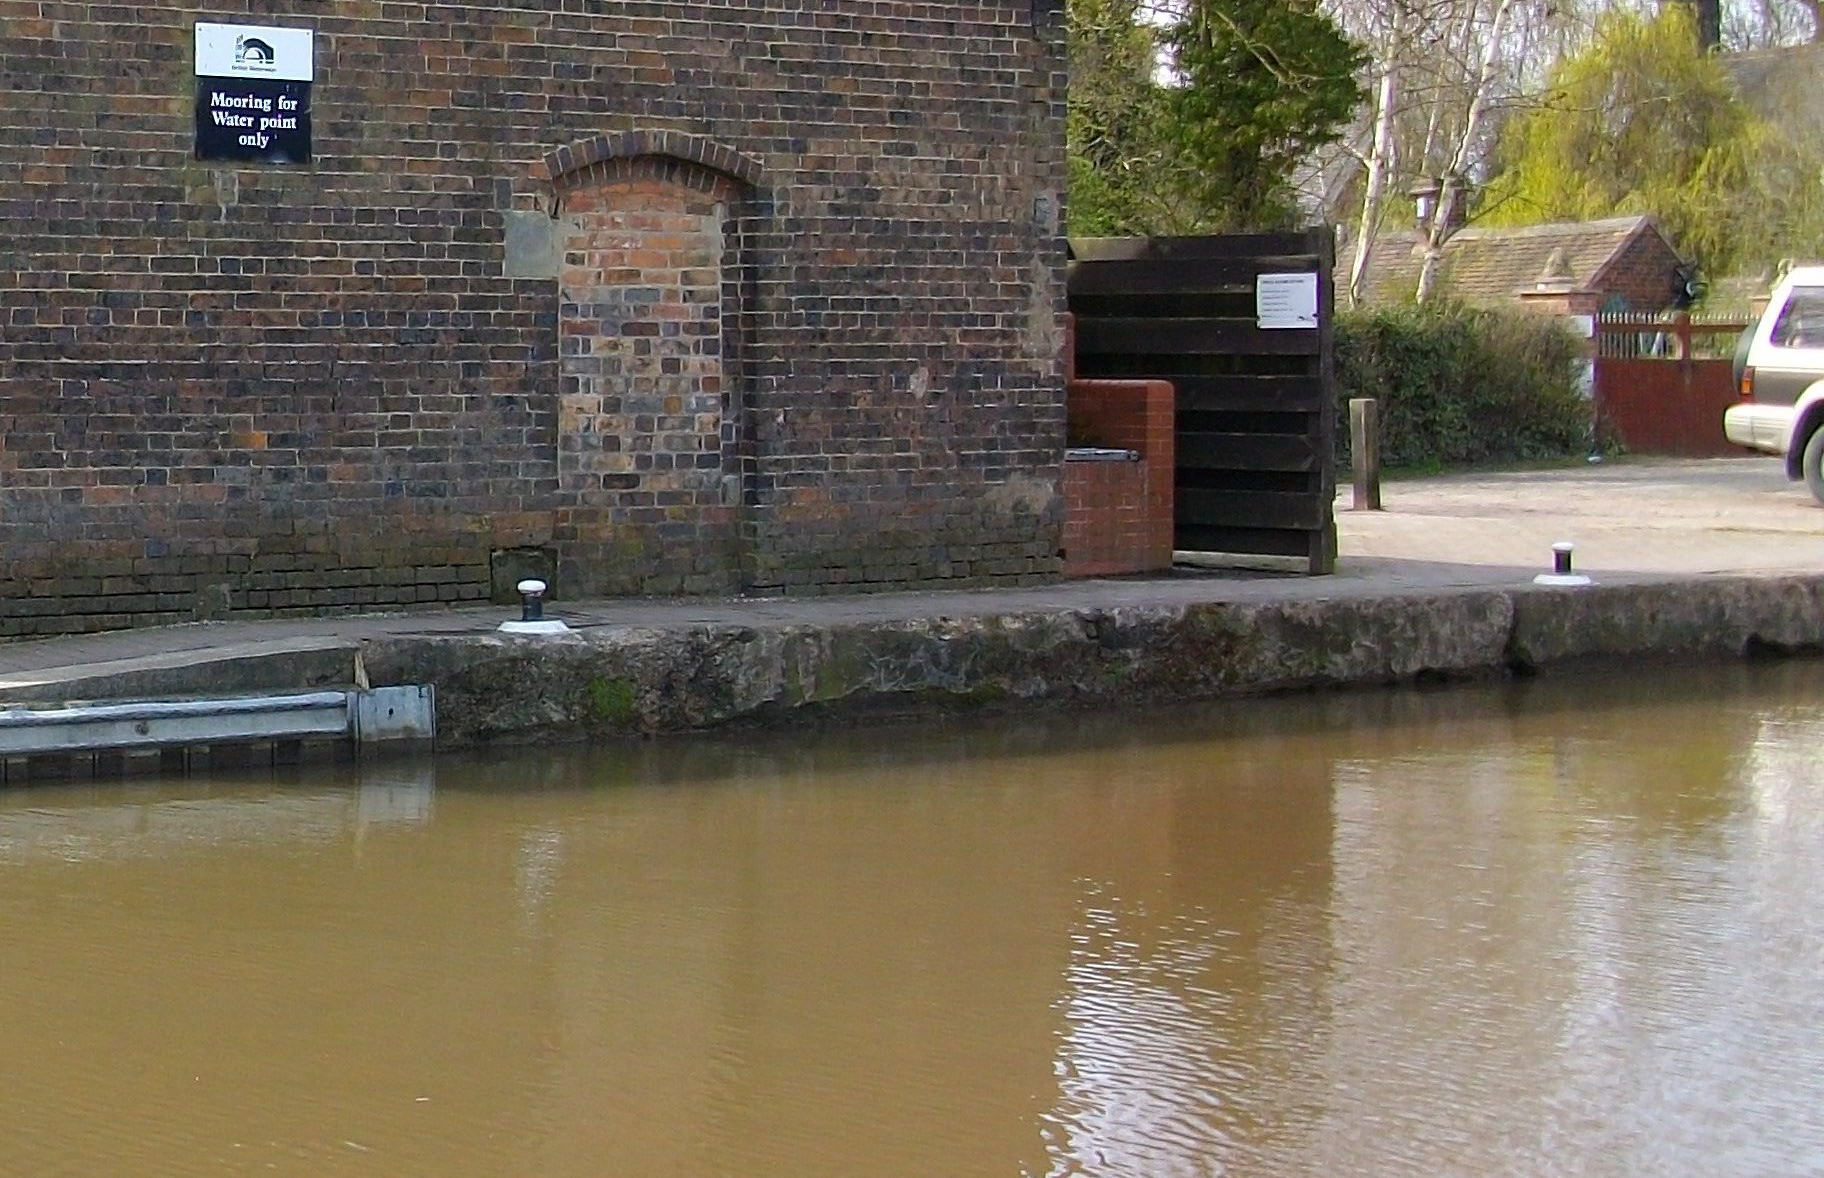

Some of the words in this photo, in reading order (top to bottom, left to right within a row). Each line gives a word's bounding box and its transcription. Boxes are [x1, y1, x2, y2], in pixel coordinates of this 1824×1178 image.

[211, 92, 272, 112] Mooring
[278, 95, 298, 111] for
[212, 111, 254, 128] Water
[260, 114, 297, 130] point
[239, 132, 269, 148] only
